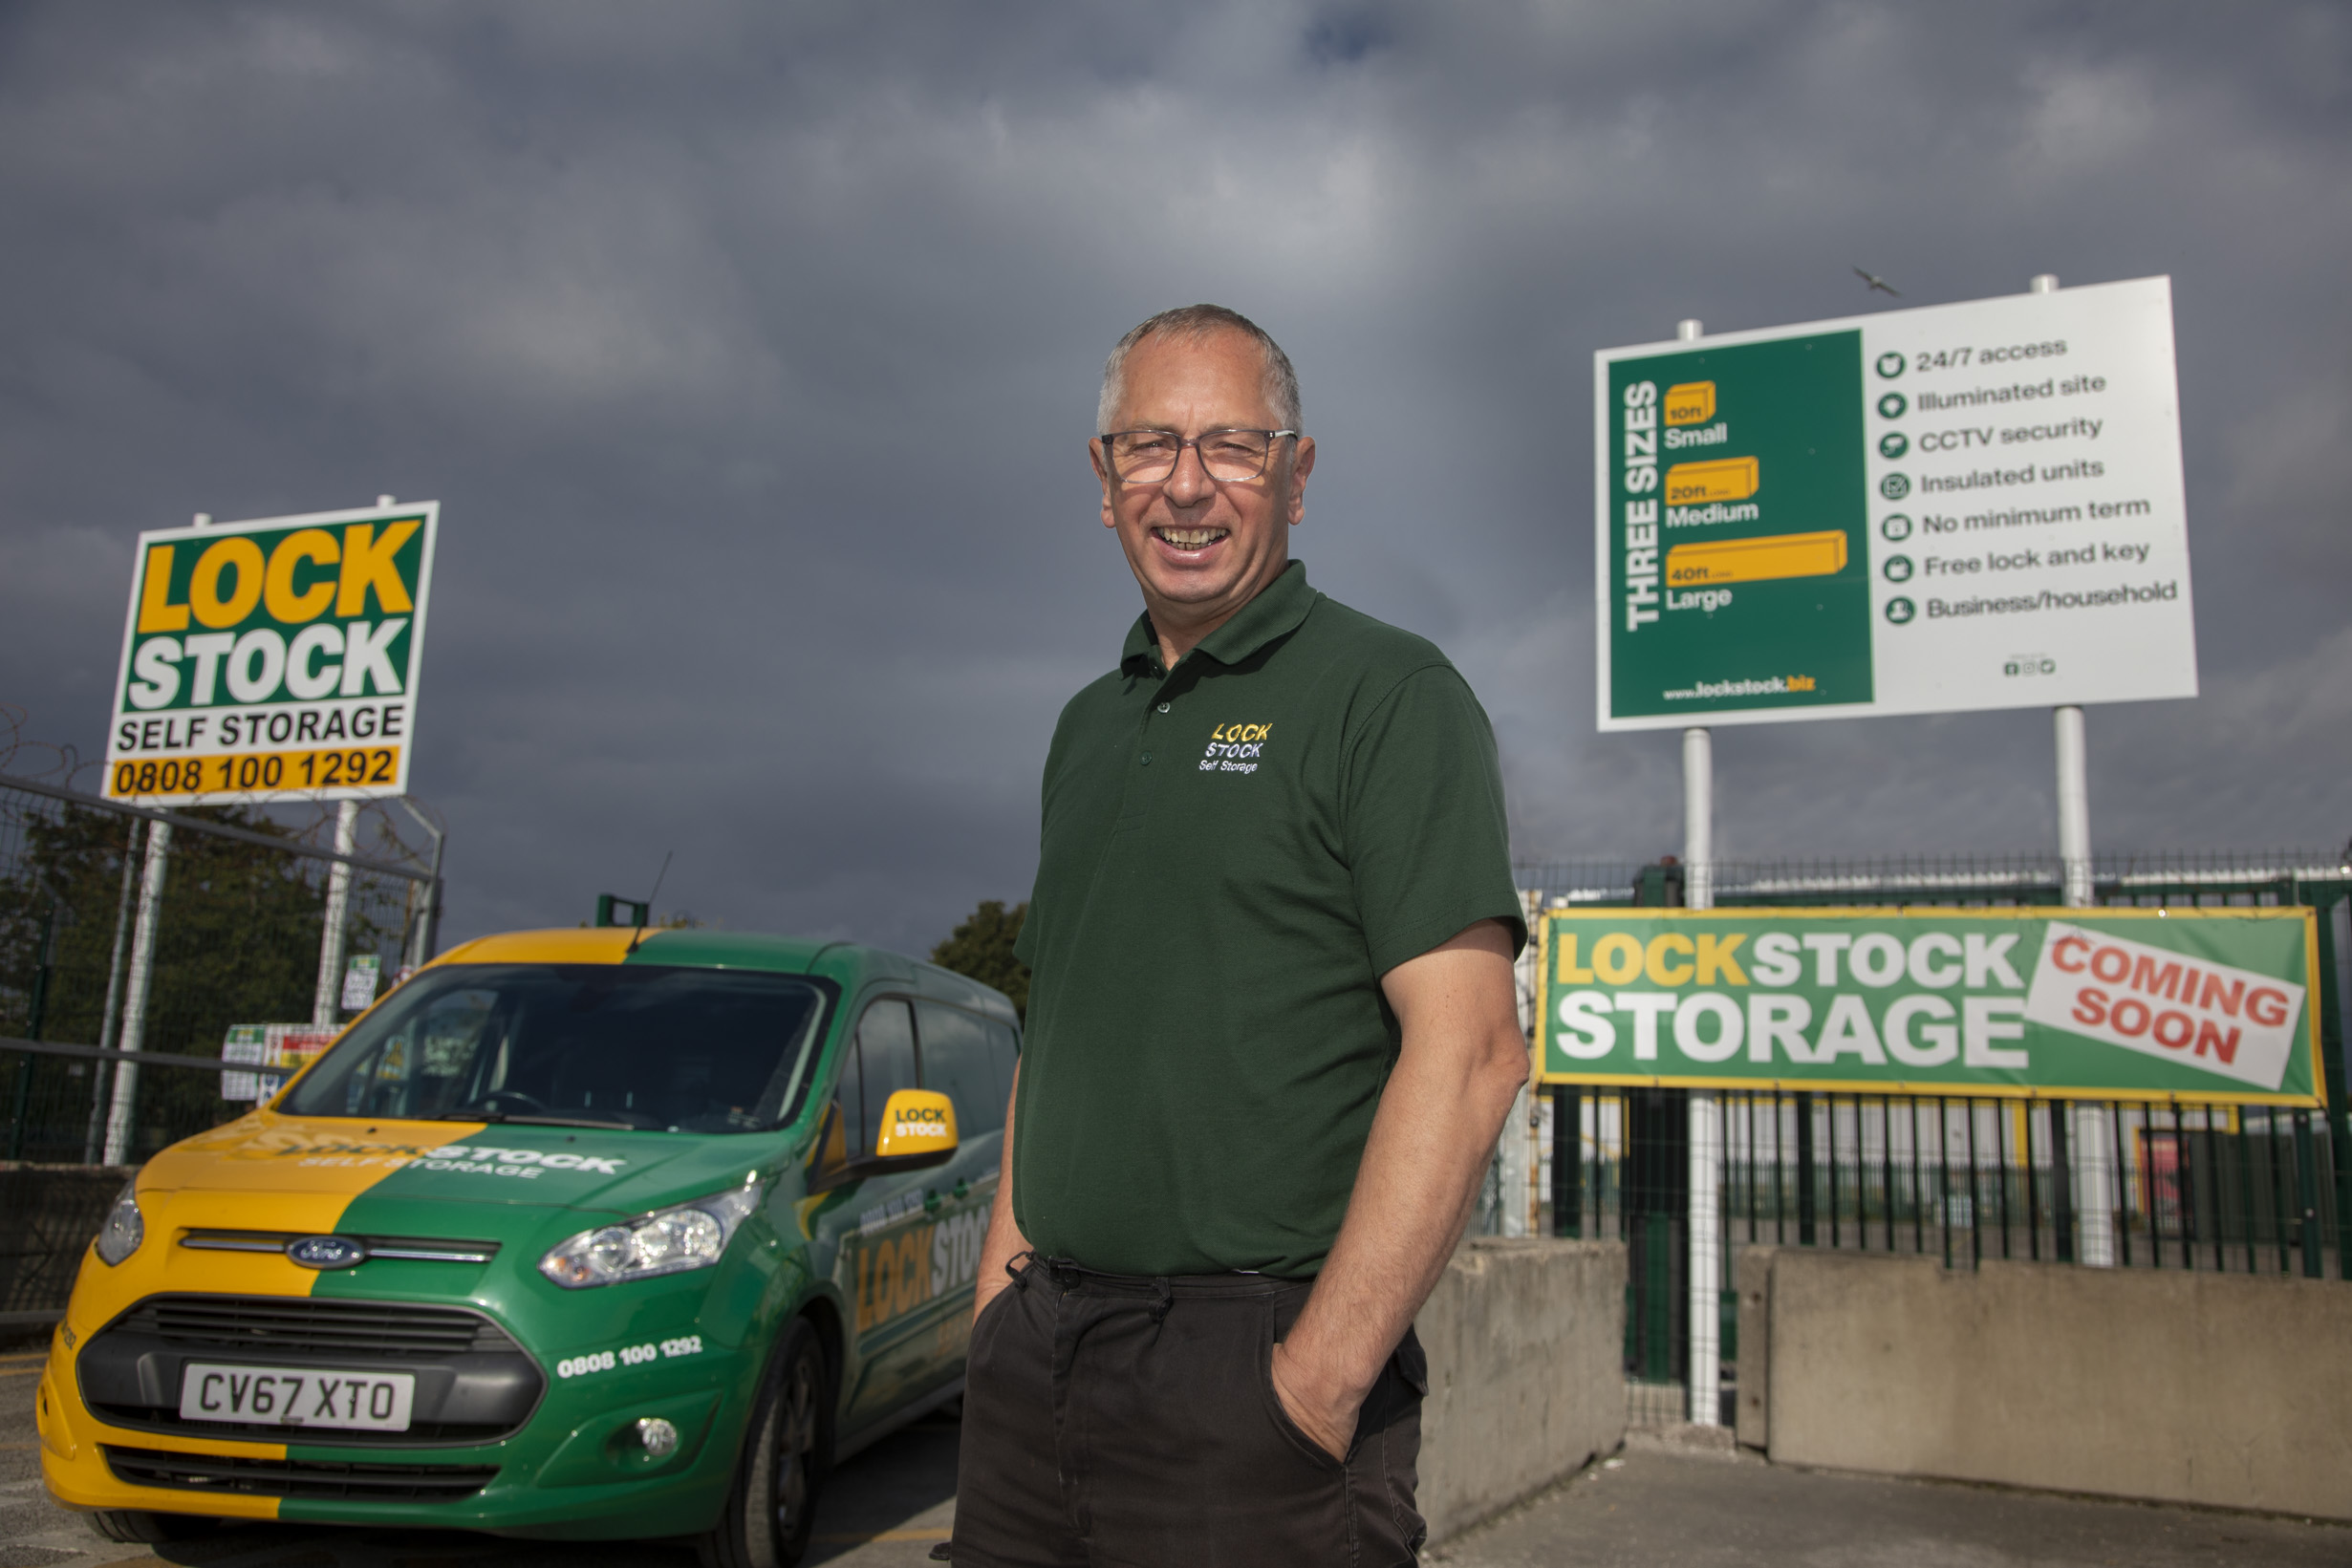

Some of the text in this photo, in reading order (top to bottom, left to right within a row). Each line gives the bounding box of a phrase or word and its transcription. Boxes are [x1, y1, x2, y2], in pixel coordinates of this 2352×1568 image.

[1916, 338, 2068, 373] 24/7 access
[1917, 375, 2107, 412] Illuminated site
[1670, 406, 1701, 420] 10ft
[1664, 422, 1727, 449] Small
[1919, 416, 2104, 453] CCTV security
[1670, 484, 1707, 501] 20ft
[1921, 459, 2105, 494] Insulated units
[1624, 380, 1659, 632] THREE SIZES
[1665, 503, 1759, 528] Medium
[1923, 497, 2151, 535] No minimum term
[1672, 567, 1710, 582] 40ft
[1925, 540, 2150, 576] Free lock and key
[137, 519, 423, 634] LOCK
[1666, 589, 1733, 612] Large
[1927, 580, 2178, 619] Business/household
[128, 617, 409, 710] STOCK
[1663, 674, 1816, 700] www.lockstock.biz
[117, 704, 405, 751] SELF STORAGE
[1211, 722, 1273, 742] LOCK
[1198, 760, 1258, 775] Self Storage
[1205, 741, 1263, 759] STOCK
[116, 749, 393, 794] 0808 100 1292
[2050, 935, 2290, 1028] COMING
[1556, 990, 2029, 1069] STORAGE
[2071, 987, 2242, 1066] SOON
[895, 1107, 946, 1124] LOCK
[895, 1122, 947, 1138] STOCK
[298, 1156, 546, 1179] SELF STORAGE
[300, 1240, 345, 1259] Ford
[557, 1335, 703, 1379] 0808 100 1292
[199, 1372, 395, 1421] CV67 XTO
